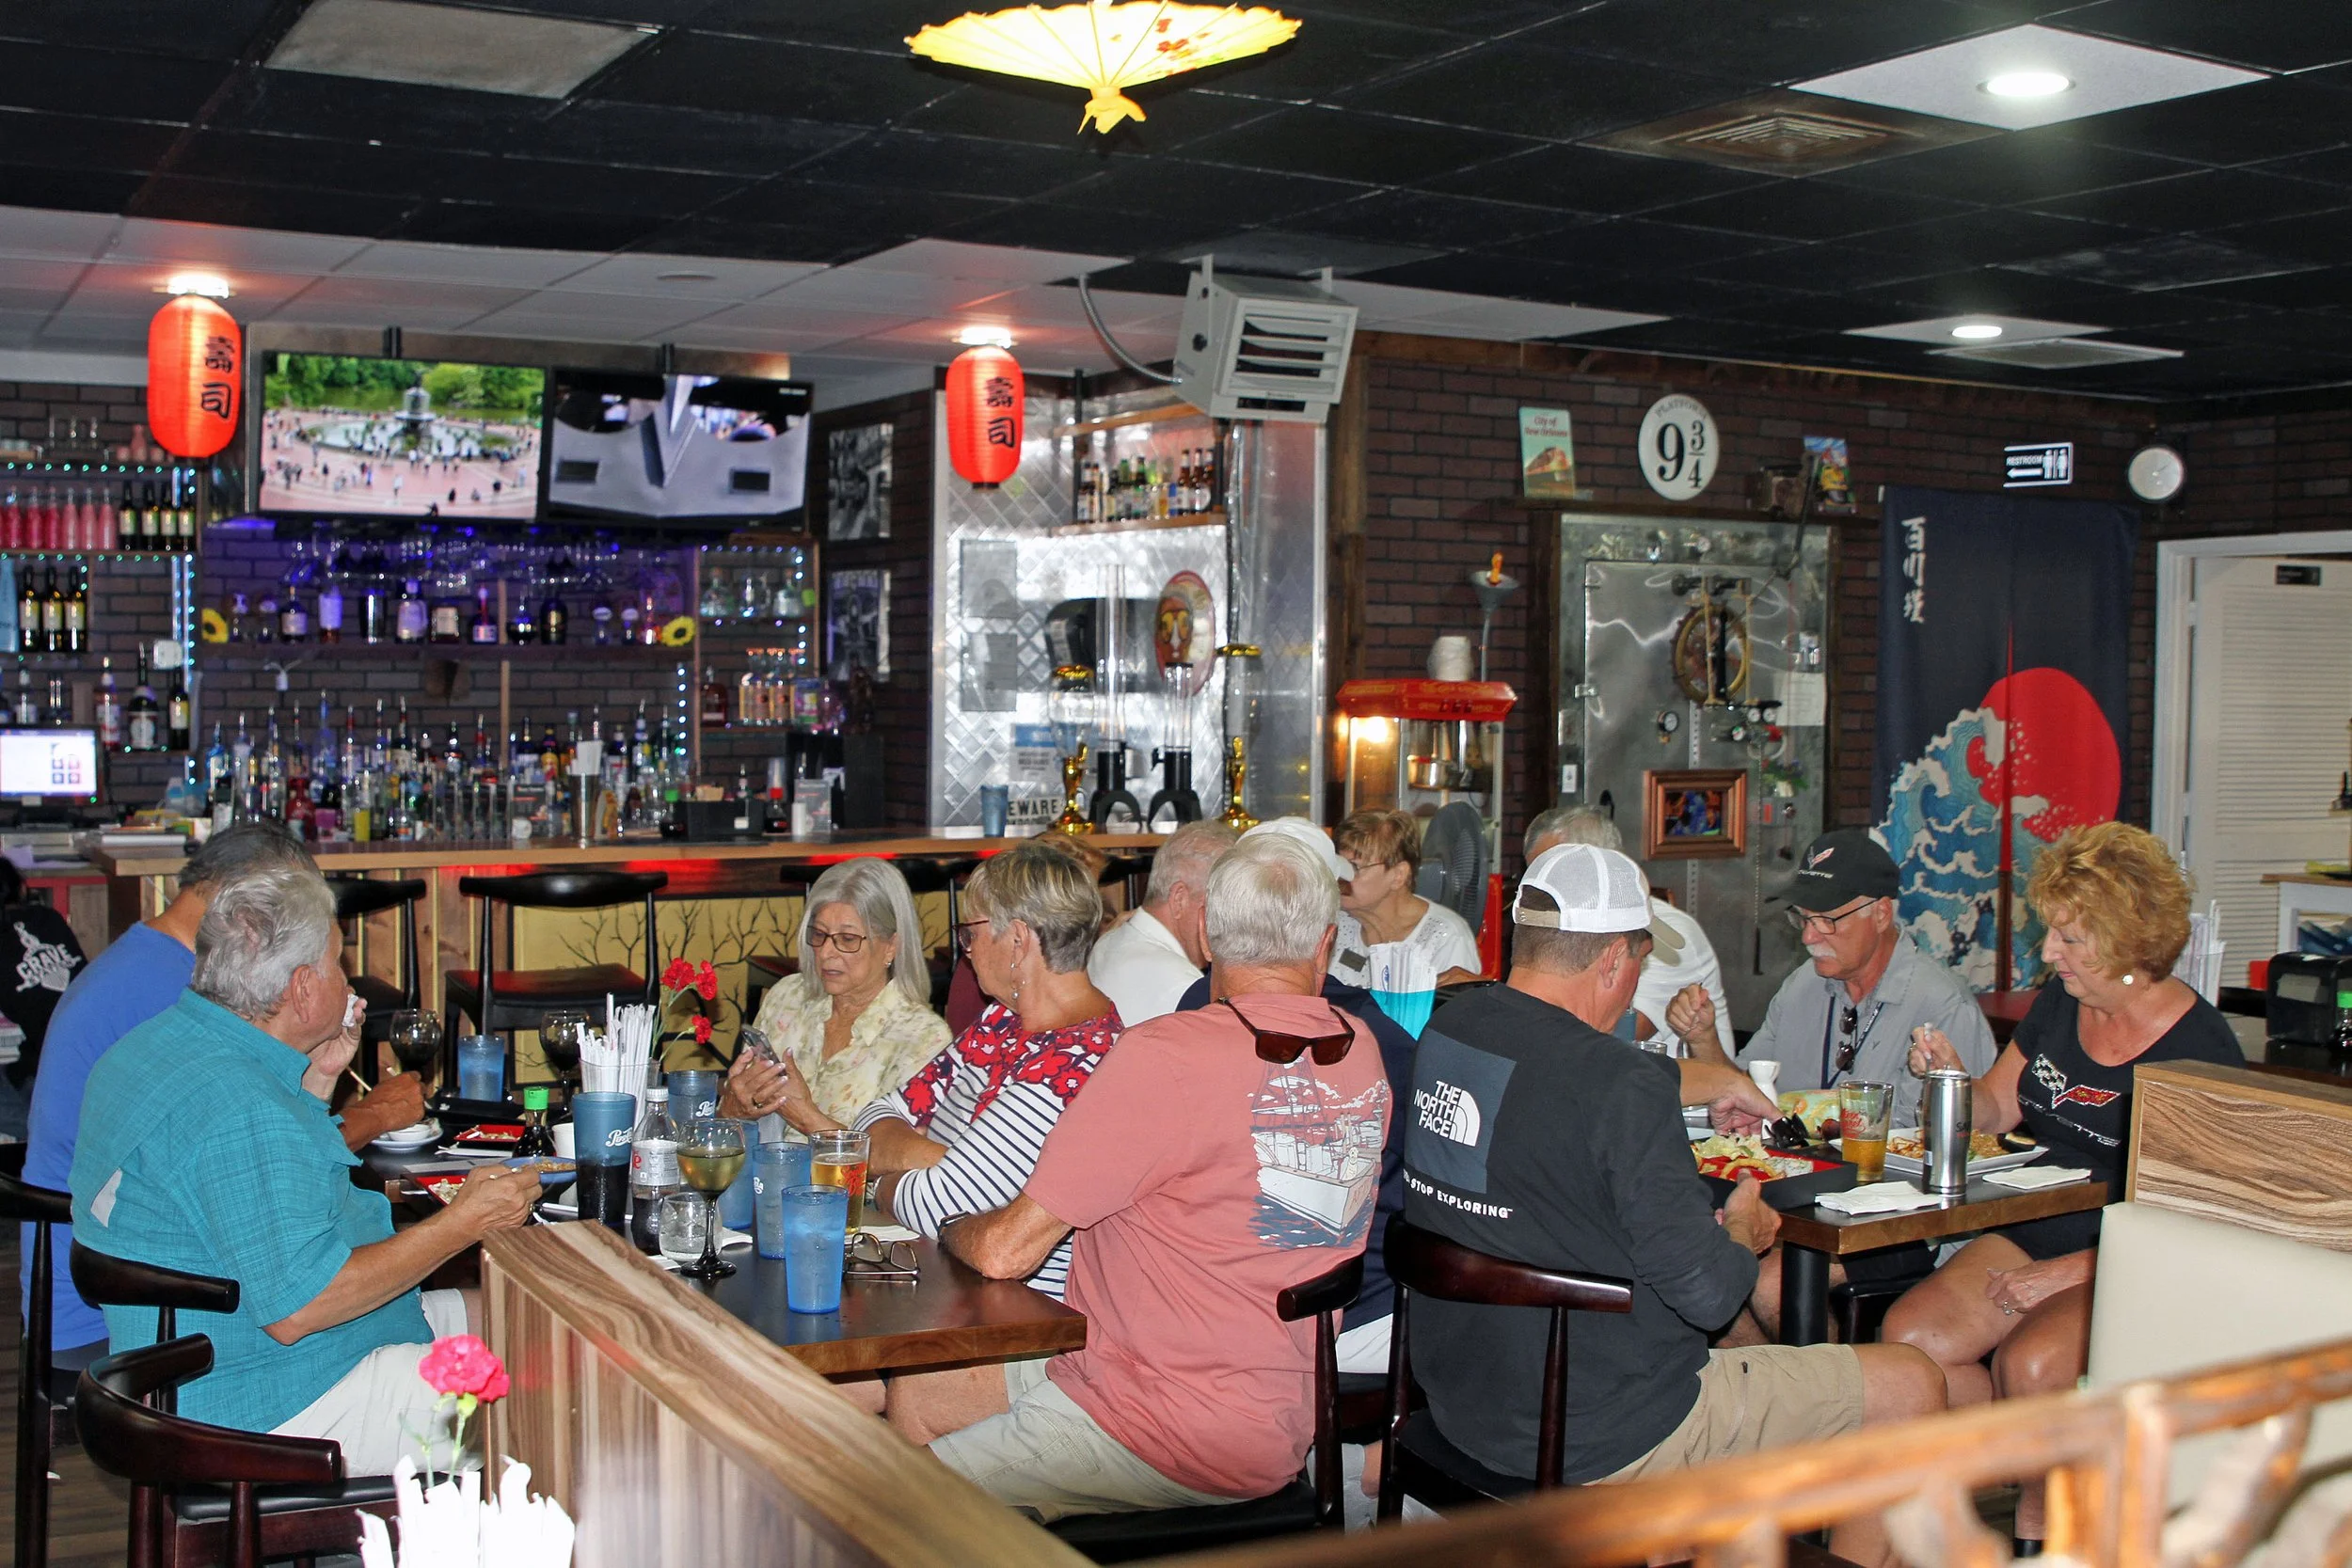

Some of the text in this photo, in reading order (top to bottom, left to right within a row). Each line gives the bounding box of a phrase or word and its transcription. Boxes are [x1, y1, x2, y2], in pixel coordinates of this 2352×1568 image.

[2006, 454, 2043, 467] RESTROOM
[1008, 799, 1058, 816] EWARE
[16, 943, 74, 980] CRAVE
[1414, 1089, 1456, 1121] NORTH
[1436, 1081, 1462, 1104] THE
[1419, 1110, 1452, 1138] FACE
[1411, 1178, 1434, 1196] STOP
[1437, 1189, 1510, 1218] EXPLORING
